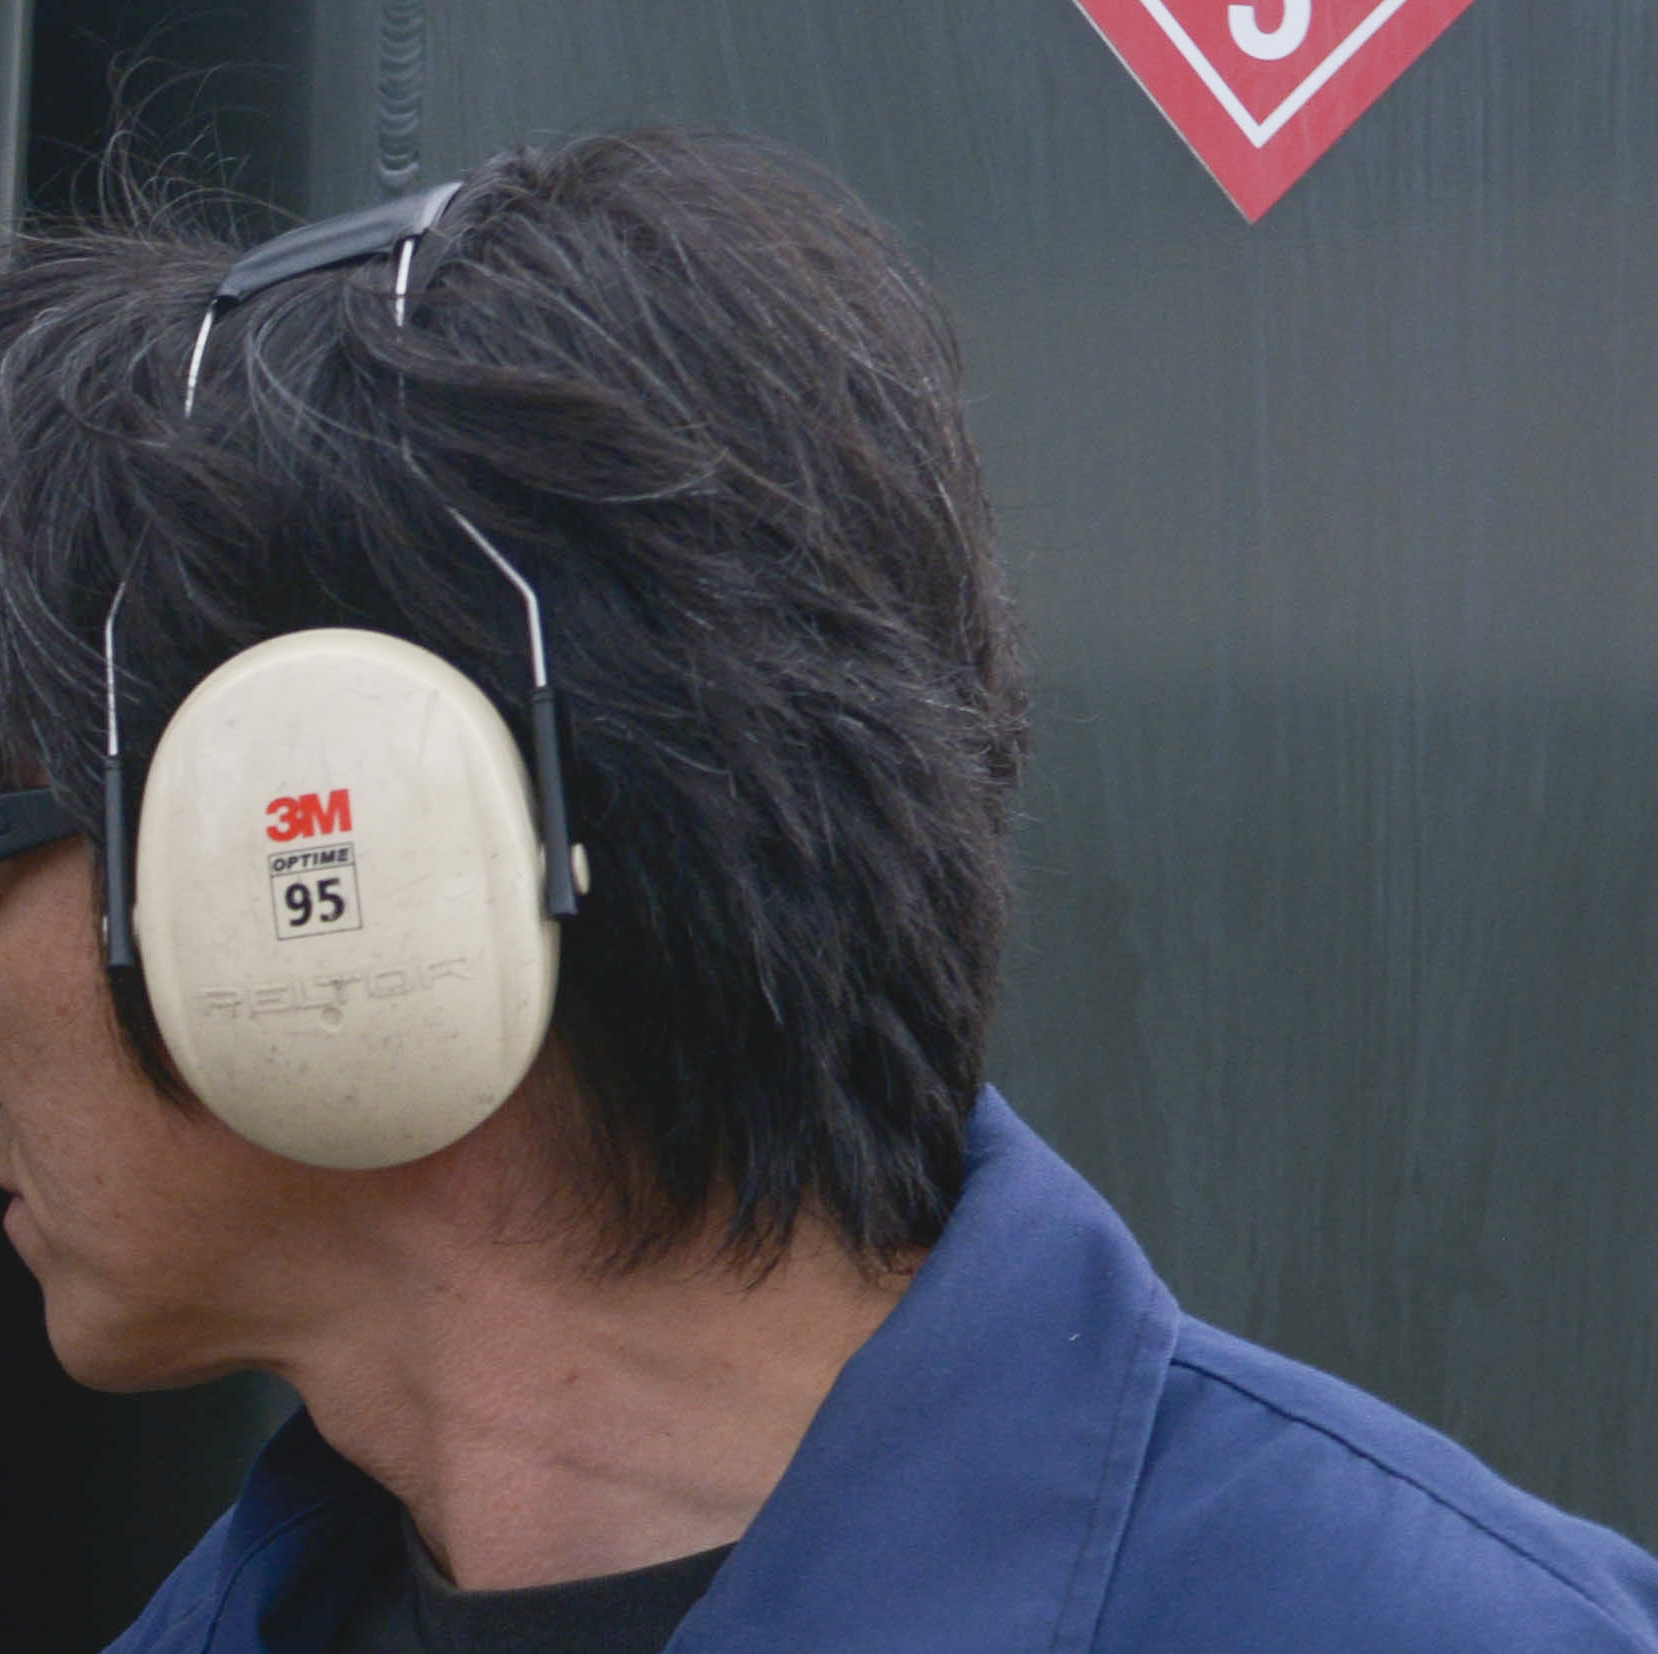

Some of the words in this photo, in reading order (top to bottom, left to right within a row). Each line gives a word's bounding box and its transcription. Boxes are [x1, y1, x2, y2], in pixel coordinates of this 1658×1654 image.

[265, 789, 353, 842] 3M
[273, 848, 350, 873] OPTIME
[285, 877, 346, 927] 95
